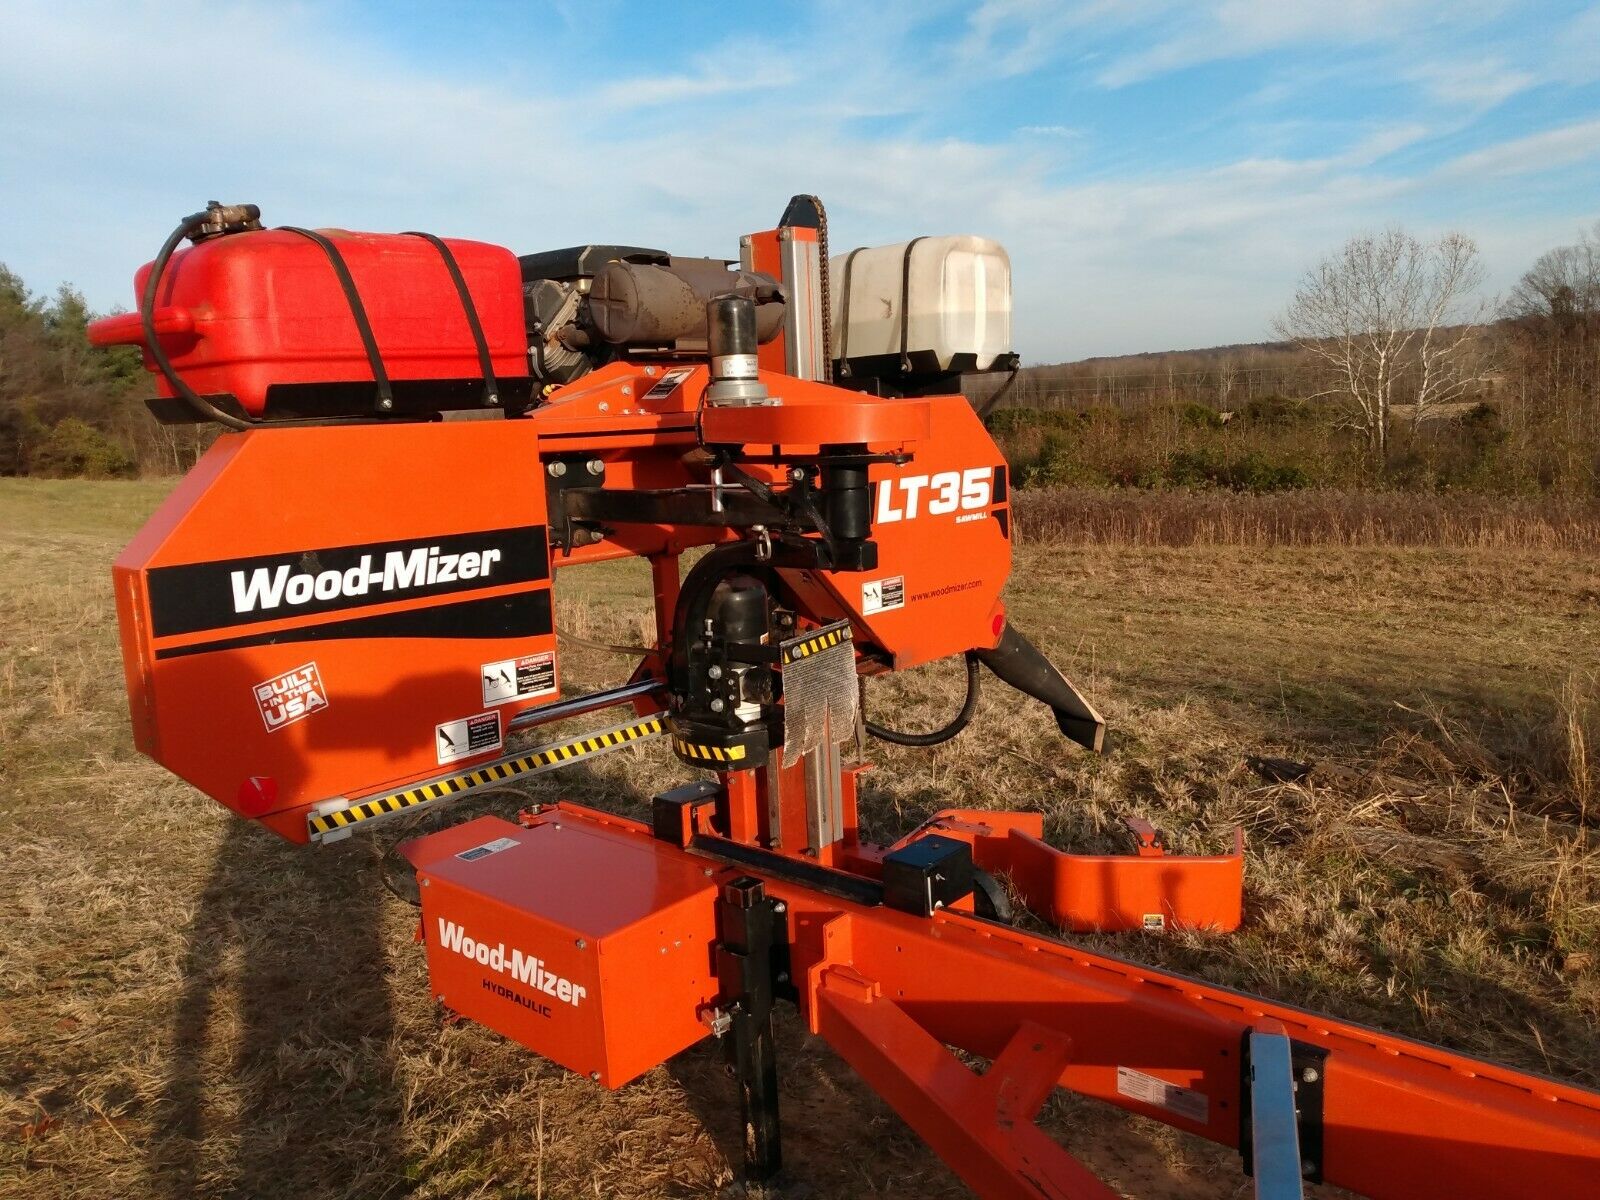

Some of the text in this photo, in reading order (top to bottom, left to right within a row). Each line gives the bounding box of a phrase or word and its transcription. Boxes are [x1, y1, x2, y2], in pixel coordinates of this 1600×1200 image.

[877, 467, 991, 524] LT35
[955, 512, 987, 524] SAWMILL
[230, 546, 501, 613] Wood-Mizer
[910, 580, 982, 602] www.woodmizer.com
[257, 666, 314, 701] BUILT
[269, 682, 312, 707] IN THE
[265, 690, 325, 726] USA
[438, 917, 586, 1007] Wood-Mizer
[482, 978, 552, 1018] HYDRAULIC
